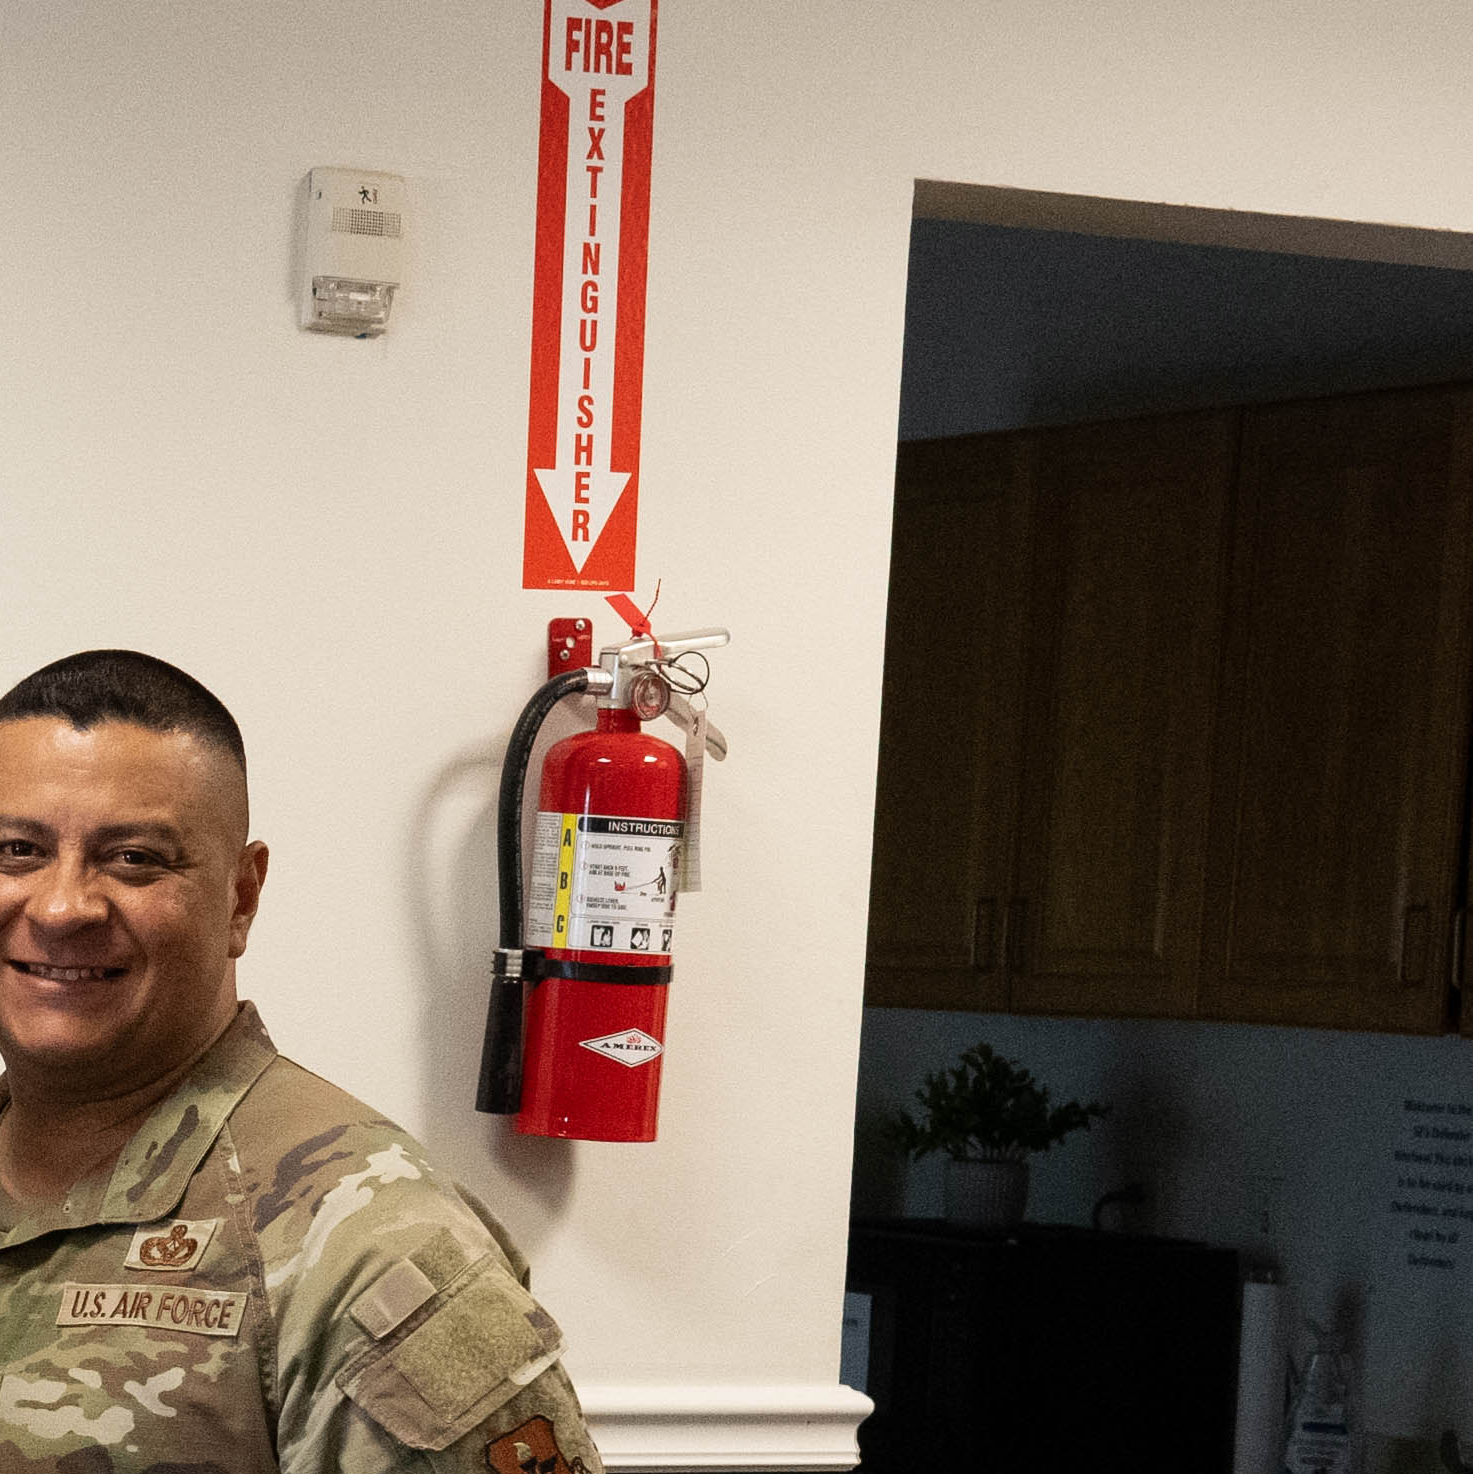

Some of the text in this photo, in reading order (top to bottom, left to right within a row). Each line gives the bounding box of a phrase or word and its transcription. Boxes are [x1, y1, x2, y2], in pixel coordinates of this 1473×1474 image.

[564, 16, 634, 76] FIRE
[571, 88, 606, 543] EXTINGUISHER
[563, 828, 572, 847] A
[559, 871, 568, 890] B
[556, 914, 565, 933] C
[600, 1042, 657, 1052] AMEREX
[71, 1290, 235, 1329] U.S. AIR FORCE
